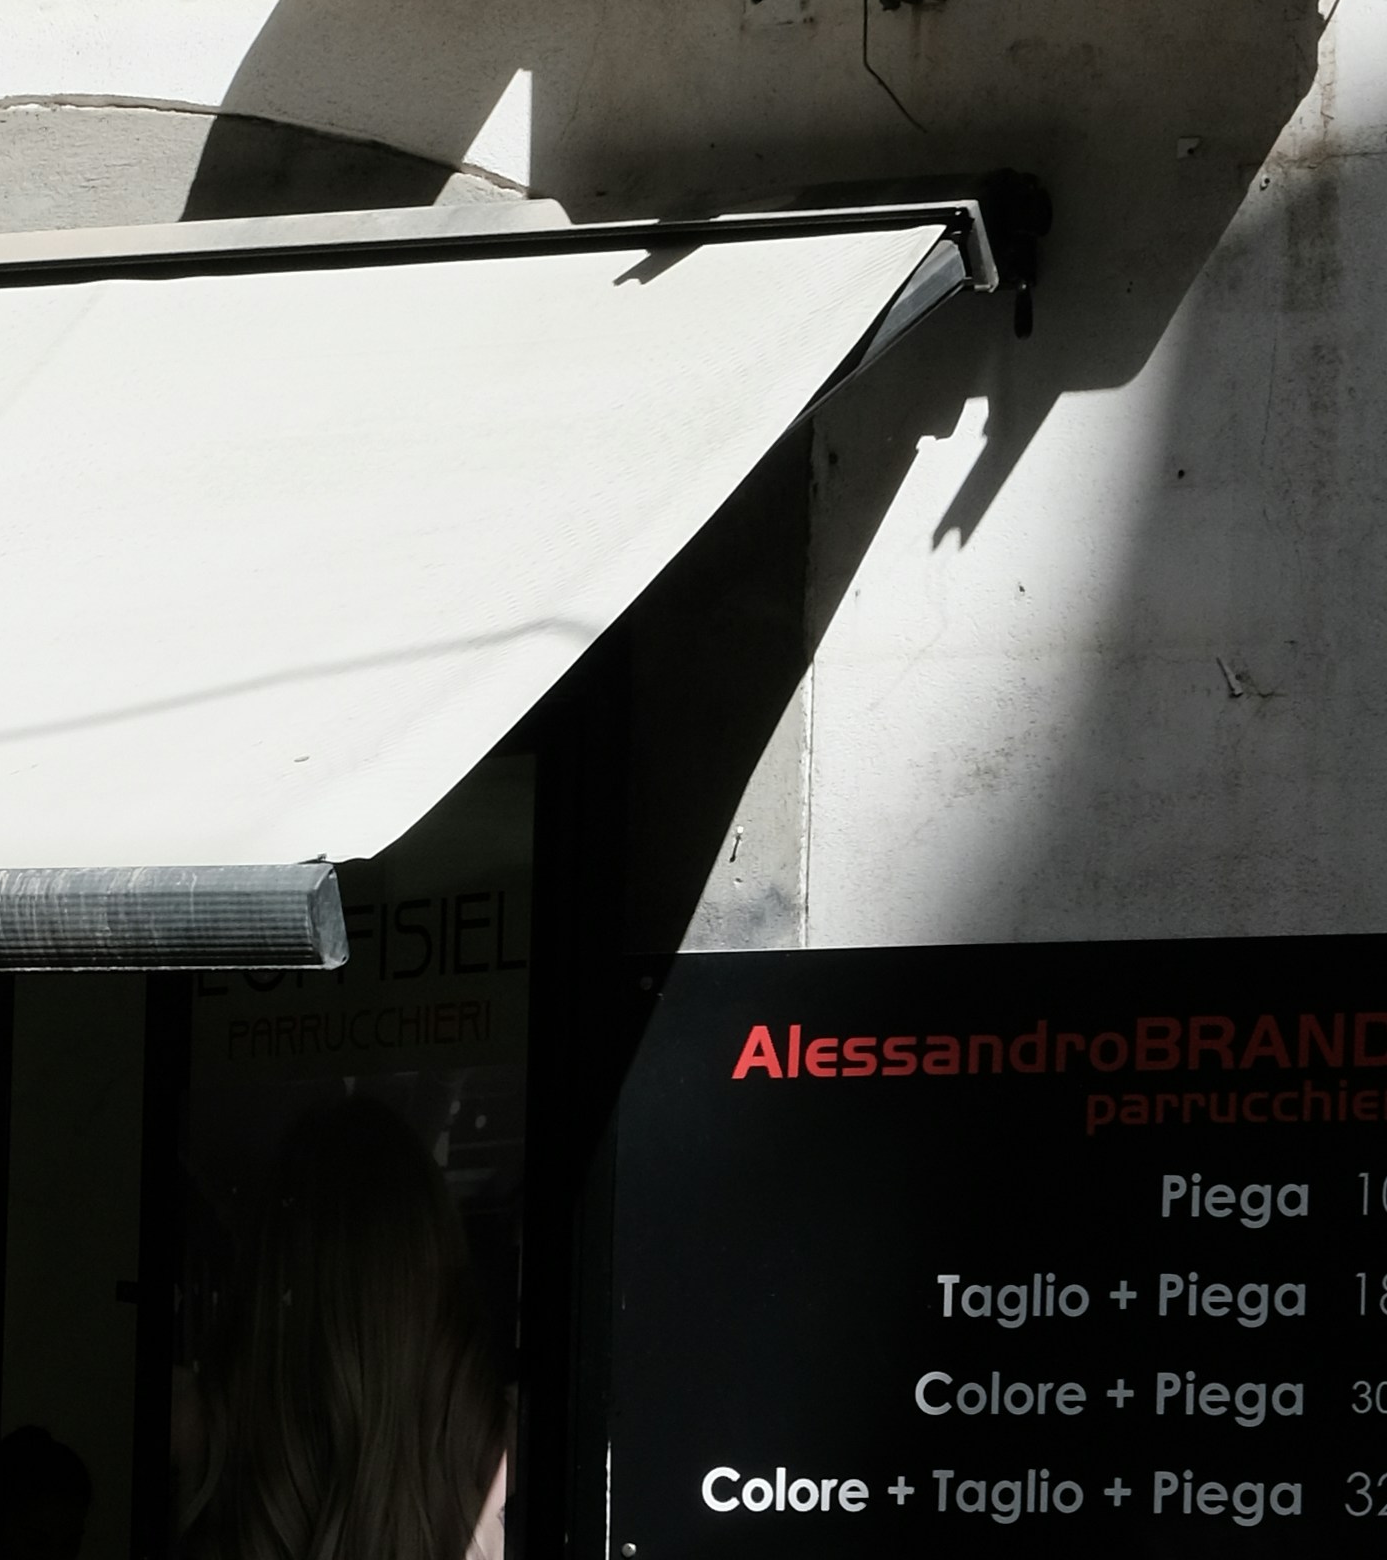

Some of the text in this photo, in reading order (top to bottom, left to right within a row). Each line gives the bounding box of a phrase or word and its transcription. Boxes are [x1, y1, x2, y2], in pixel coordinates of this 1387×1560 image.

[228, 999, 492, 1061] PARRUCCHIERI
[1085, 1077, 1387, 1137] parrucchie
[1161, 1171, 1387, 1229] Piega 1
[936, 1272, 1090, 1329] Taglio
[1109, 1280, 1138, 1310] +
[1158, 1271, 1307, 1329] Piega
[914, 1370, 1087, 1416] Colore
[1106, 1378, 1135, 1409] +
[1155, 1370, 1304, 1428] Piega
[700, 1465, 870, 1513] Colore
[887, 1475, 916, 1506] +
[932, 1468, 1084, 1525] Taglio
[1103, 1477, 1132, 1507] +
[1153, 1469, 1302, 1527] Piega
